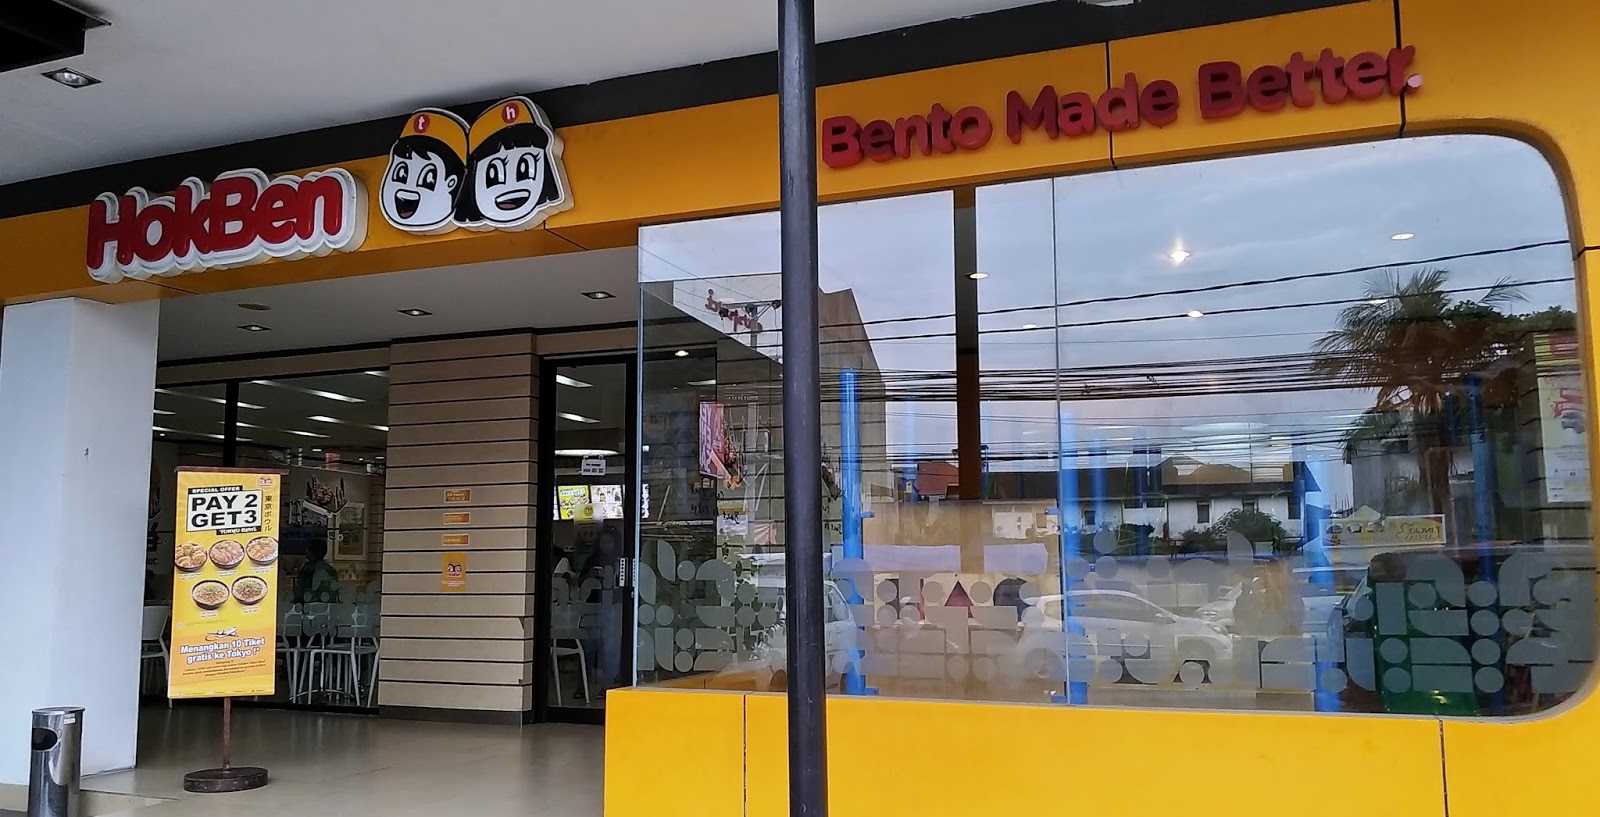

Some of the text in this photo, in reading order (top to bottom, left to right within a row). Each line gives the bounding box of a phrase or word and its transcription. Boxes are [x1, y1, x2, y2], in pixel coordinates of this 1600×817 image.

[505, 106, 516, 120] h
[821, 45, 1421, 168] Bento Made Better.
[86, 174, 344, 271] HokBen
[192, 494, 258, 511] PAY 2
[191, 510, 257, 528] GET 3
[264, 495, 273, 532] 東京ボウル
[180, 637, 265, 654] Menangkan 10 Tiket
[186, 652, 212, 665] gratis
[214, 650, 225, 660] ke
[226, 648, 252, 659] Tokyo
